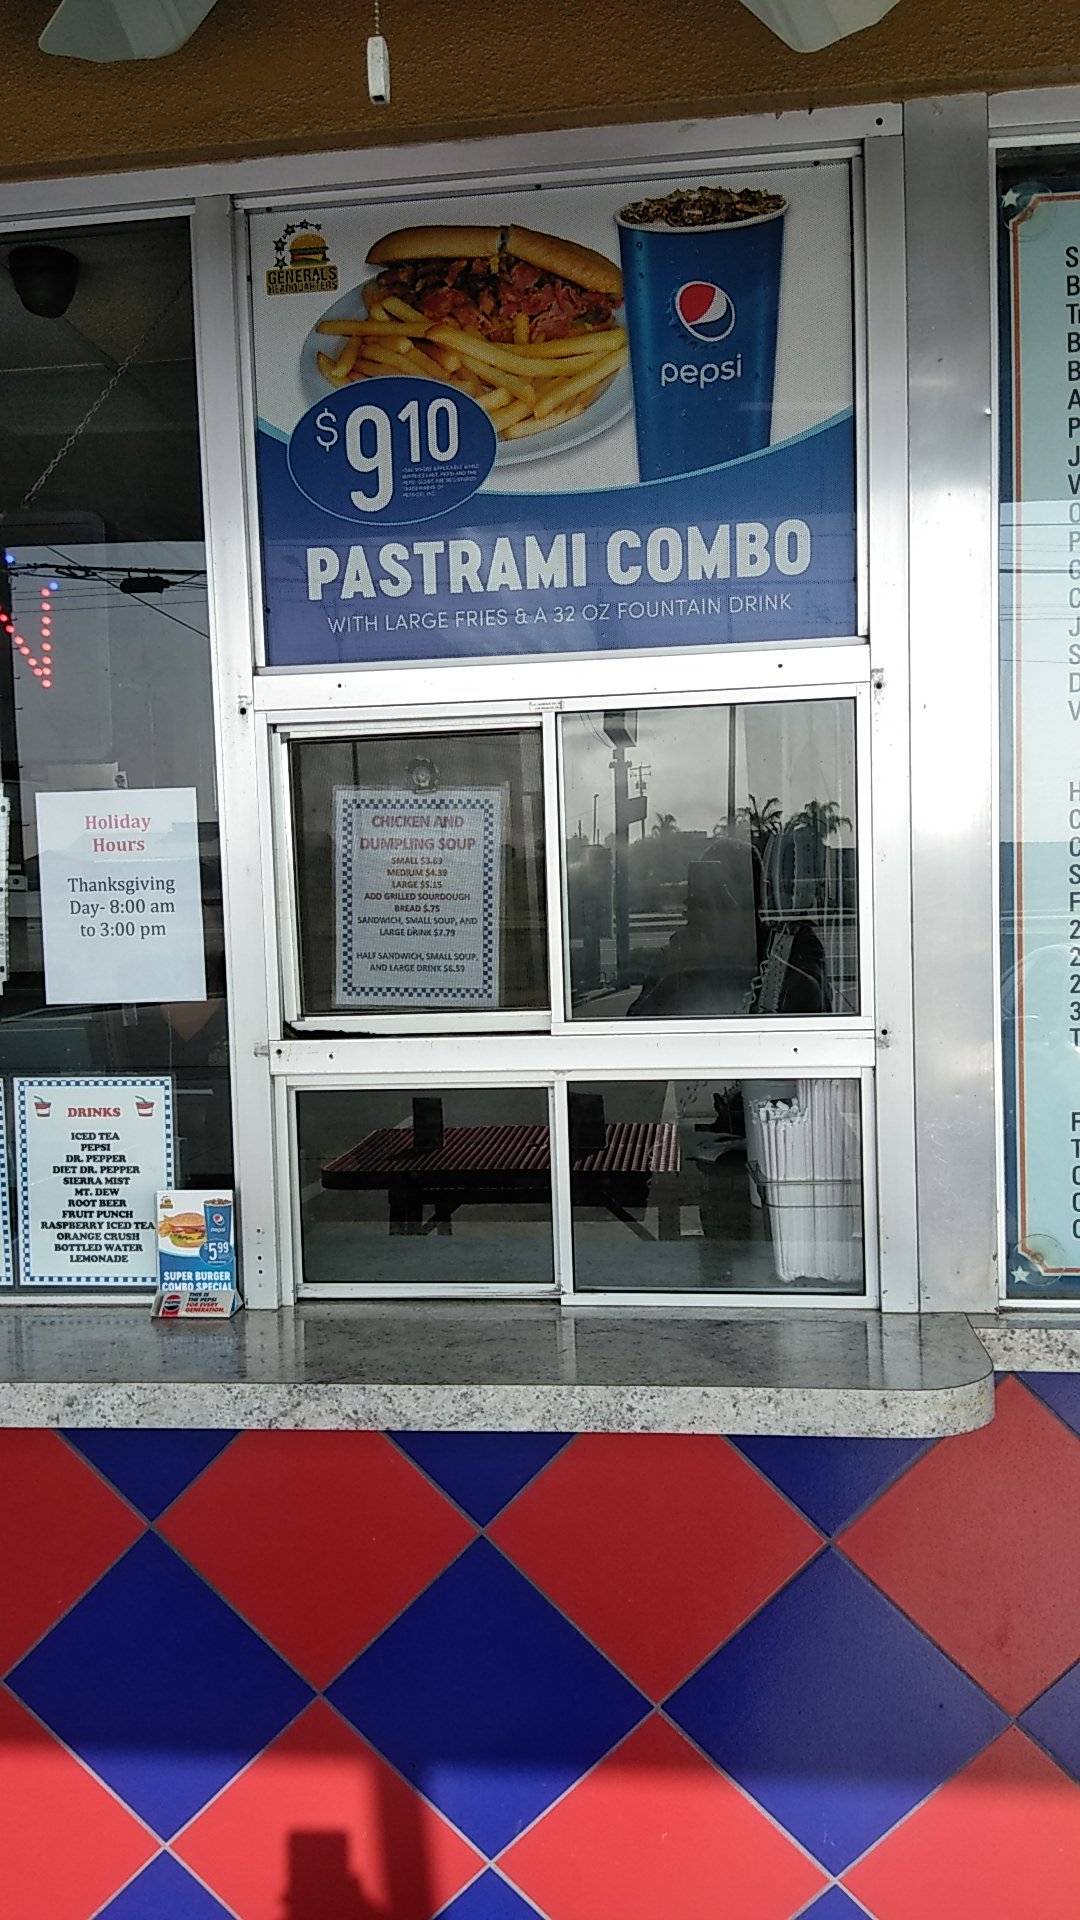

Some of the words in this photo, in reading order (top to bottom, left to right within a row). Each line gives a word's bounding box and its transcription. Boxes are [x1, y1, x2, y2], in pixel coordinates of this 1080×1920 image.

[269, 266, 337, 284] GENERALS
[660, 352, 742, 389] pepsi
[306, 532, 587, 601] PASTRAMI
[606, 518, 812, 586] COMBO
[327, 616, 378, 633] WITH
[385, 612, 448, 631] LARGE
[455, 609, 508, 627] FRIES
[515, 608, 528, 624] &
[534, 607, 547, 623] A
[553, 606, 575, 622] 32
[582, 604, 610, 621] OZ
[618, 598, 721, 619] FOUNTAIN
[729, 593, 791, 613] DRINK
[85, 814, 151, 832] Holiday
[372, 816, 430, 828] CHICKEN
[434, 816, 463, 828] AND
[93, 838, 145, 852] Hours
[360, 838, 434, 850] DUMPLING
[438, 838, 475, 850] SOUP
[67, 877, 176, 894] Thanksgiving
[70, 900, 105, 918] Day-
[110, 900, 145, 914] 8:00
[150, 901, 175, 913] am
[423, 904, 440, 912] $.75
[81, 925, 96, 937] to
[100, 922, 135, 936] 3:00
[140, 924, 166, 939] pm
[68, 1107, 121, 1118] DRINKS
[75, 1188, 92, 1196] MT.
[95, 1188, 119, 1196] DEW
[164, 1271, 193, 1281] SUPER
[195, 1271, 230, 1280] BURGER
[162, 1283, 194, 1291] COMBO
[196, 1282, 232, 1291] SPECIAL
